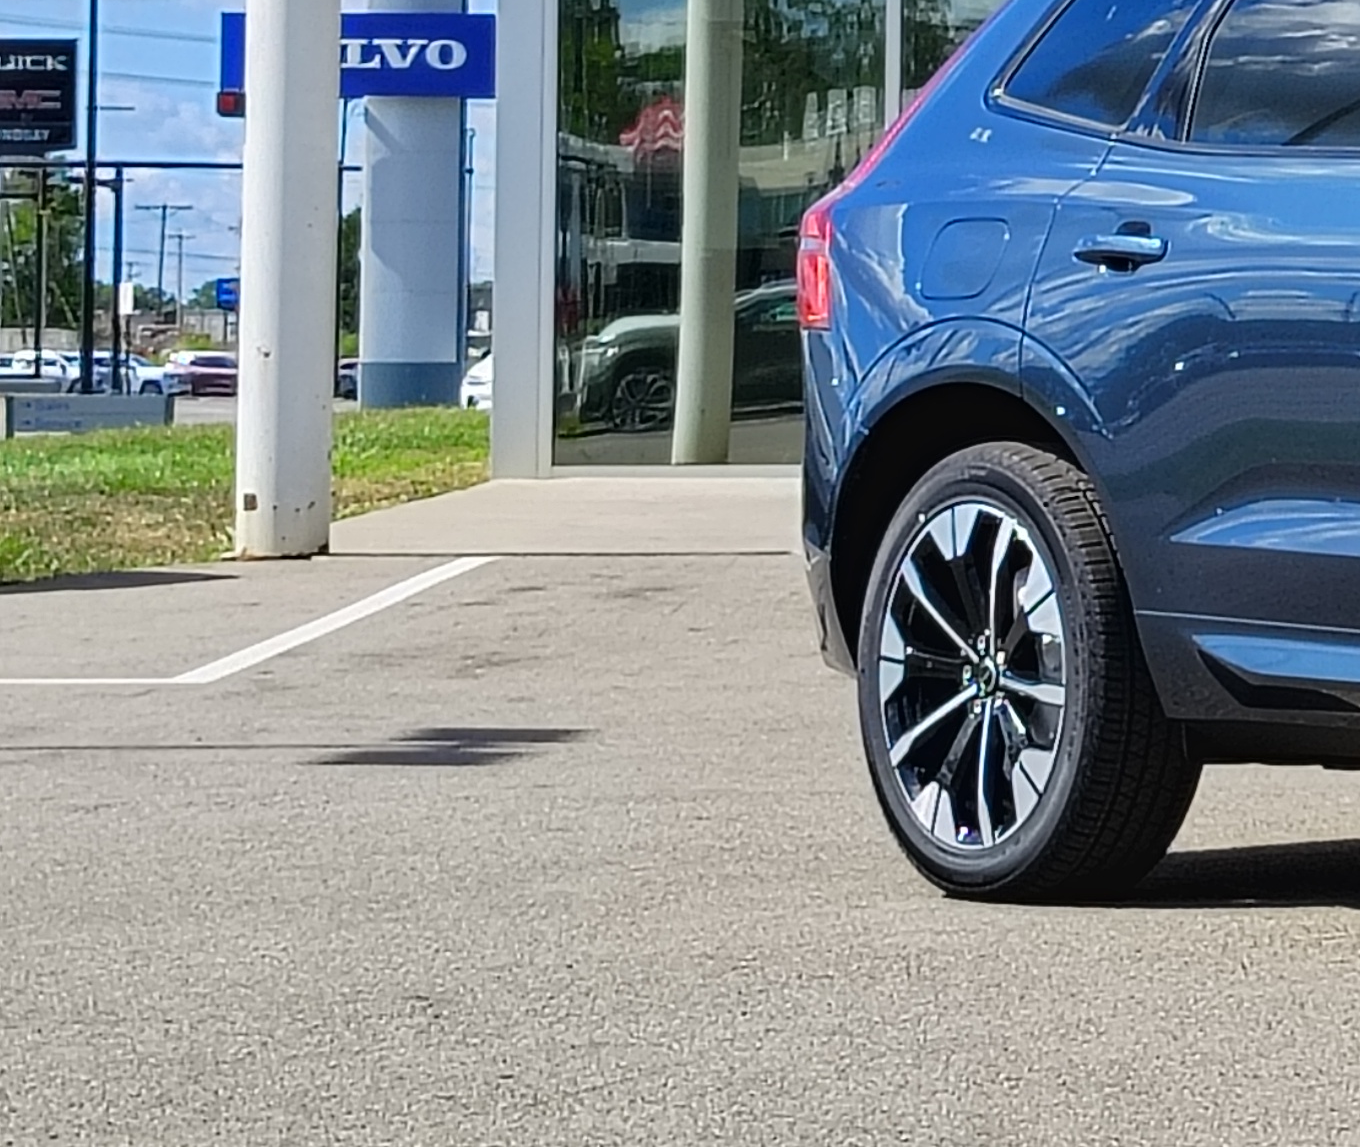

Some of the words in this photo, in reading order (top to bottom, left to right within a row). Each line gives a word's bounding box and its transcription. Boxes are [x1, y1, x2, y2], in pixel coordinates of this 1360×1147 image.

[0, 55, 67, 70] UICK
[340, 39, 467, 69] LVO
[0, 90, 61, 109] MC
